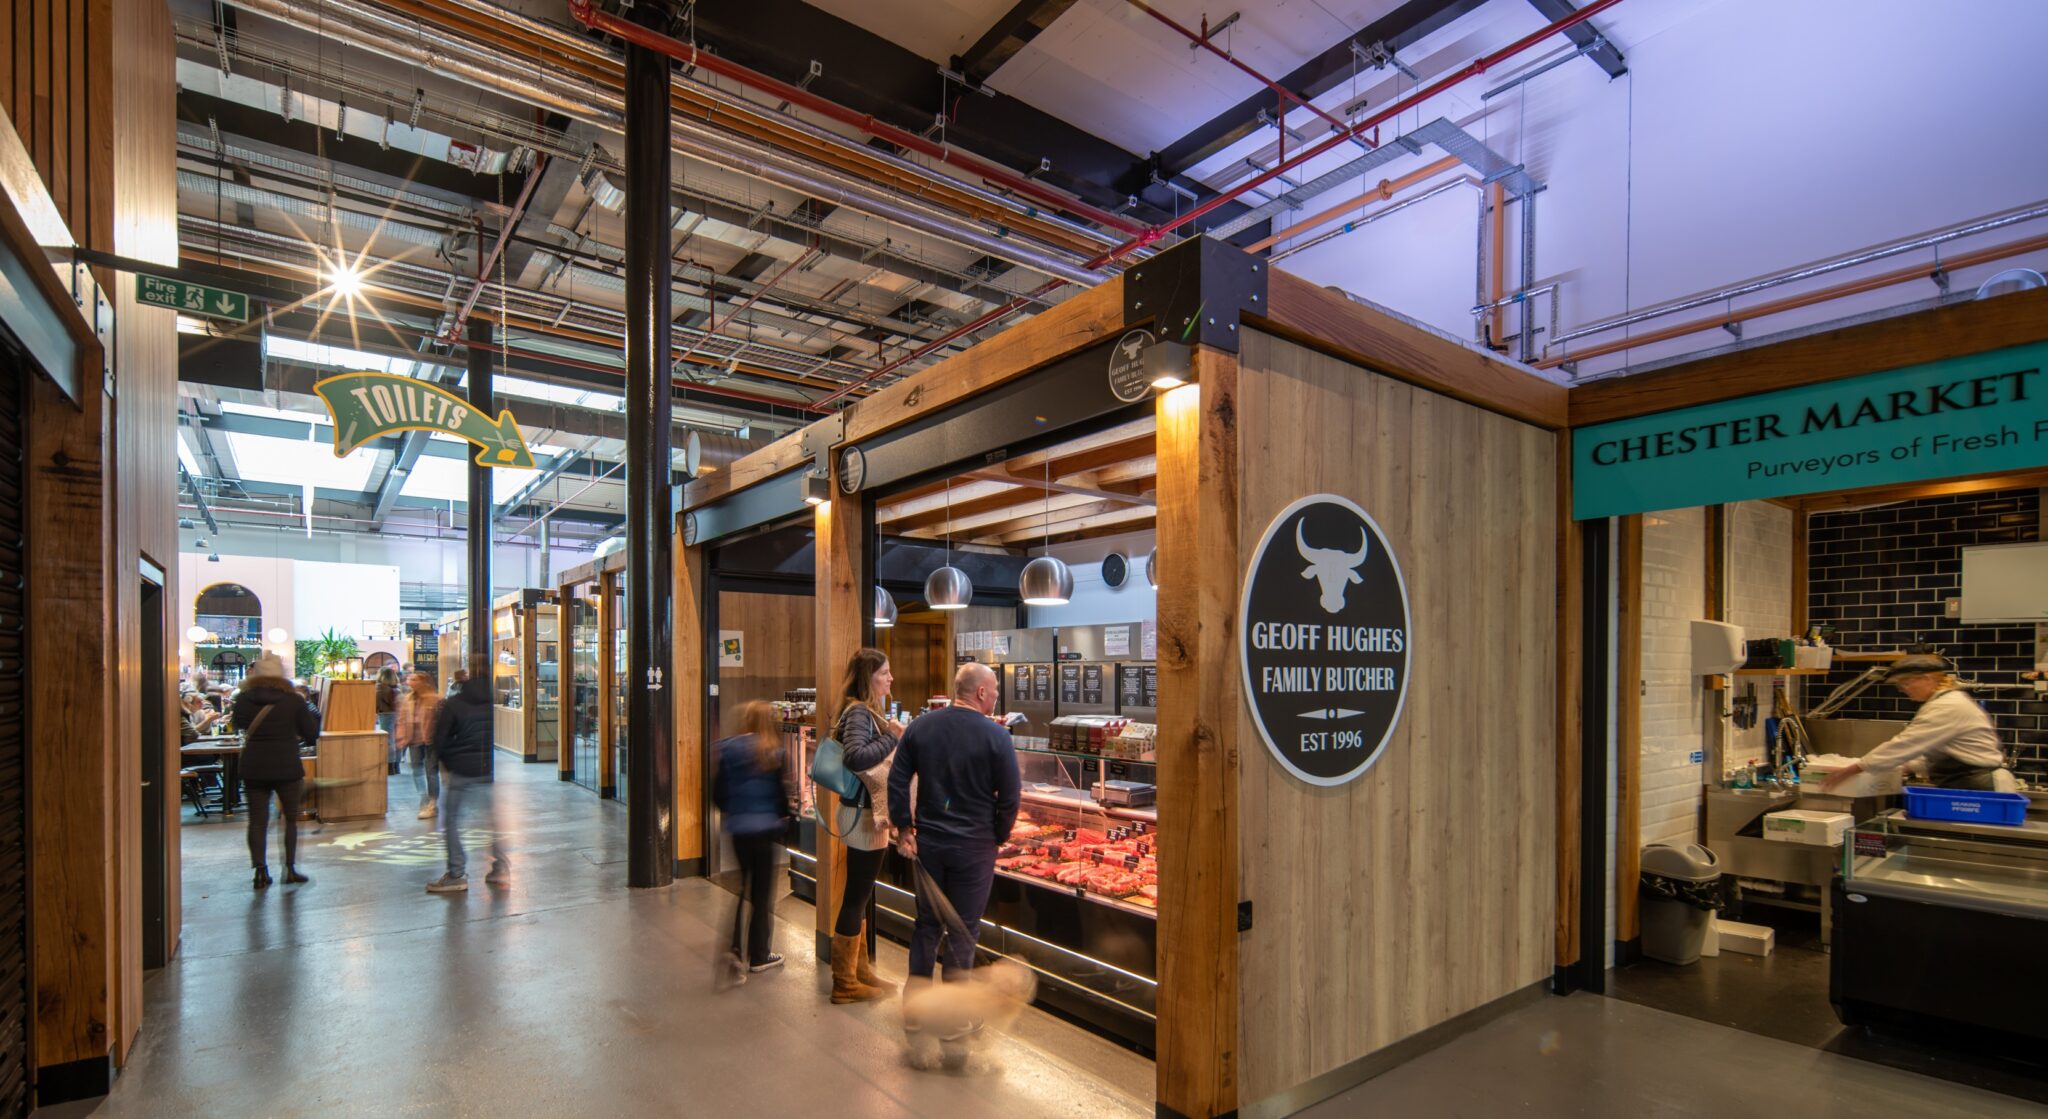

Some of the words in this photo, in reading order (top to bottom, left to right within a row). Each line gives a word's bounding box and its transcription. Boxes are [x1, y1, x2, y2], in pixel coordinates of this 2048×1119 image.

[144, 277, 177, 294] Fire
[144, 291, 177, 305] exit
[350, 384, 468, 430] TOILETS
[1591, 413, 1789, 466] CHESTER
[1799, 367, 2041, 435] MARKET
[1747, 448, 1880, 479] Purveyors
[1891, 436, 1923, 461] of
[1932, 425, 2019, 455] Fresh
[1252, 621, 1321, 650] GEOFF
[1327, 625, 1404, 653] HUGHES
[1262, 666, 1322, 693] FAMILY
[1326, 666, 1395, 692] BUTCHER
[1300, 732, 1328, 752] EST
[1331, 730, 1363, 750] 1996
